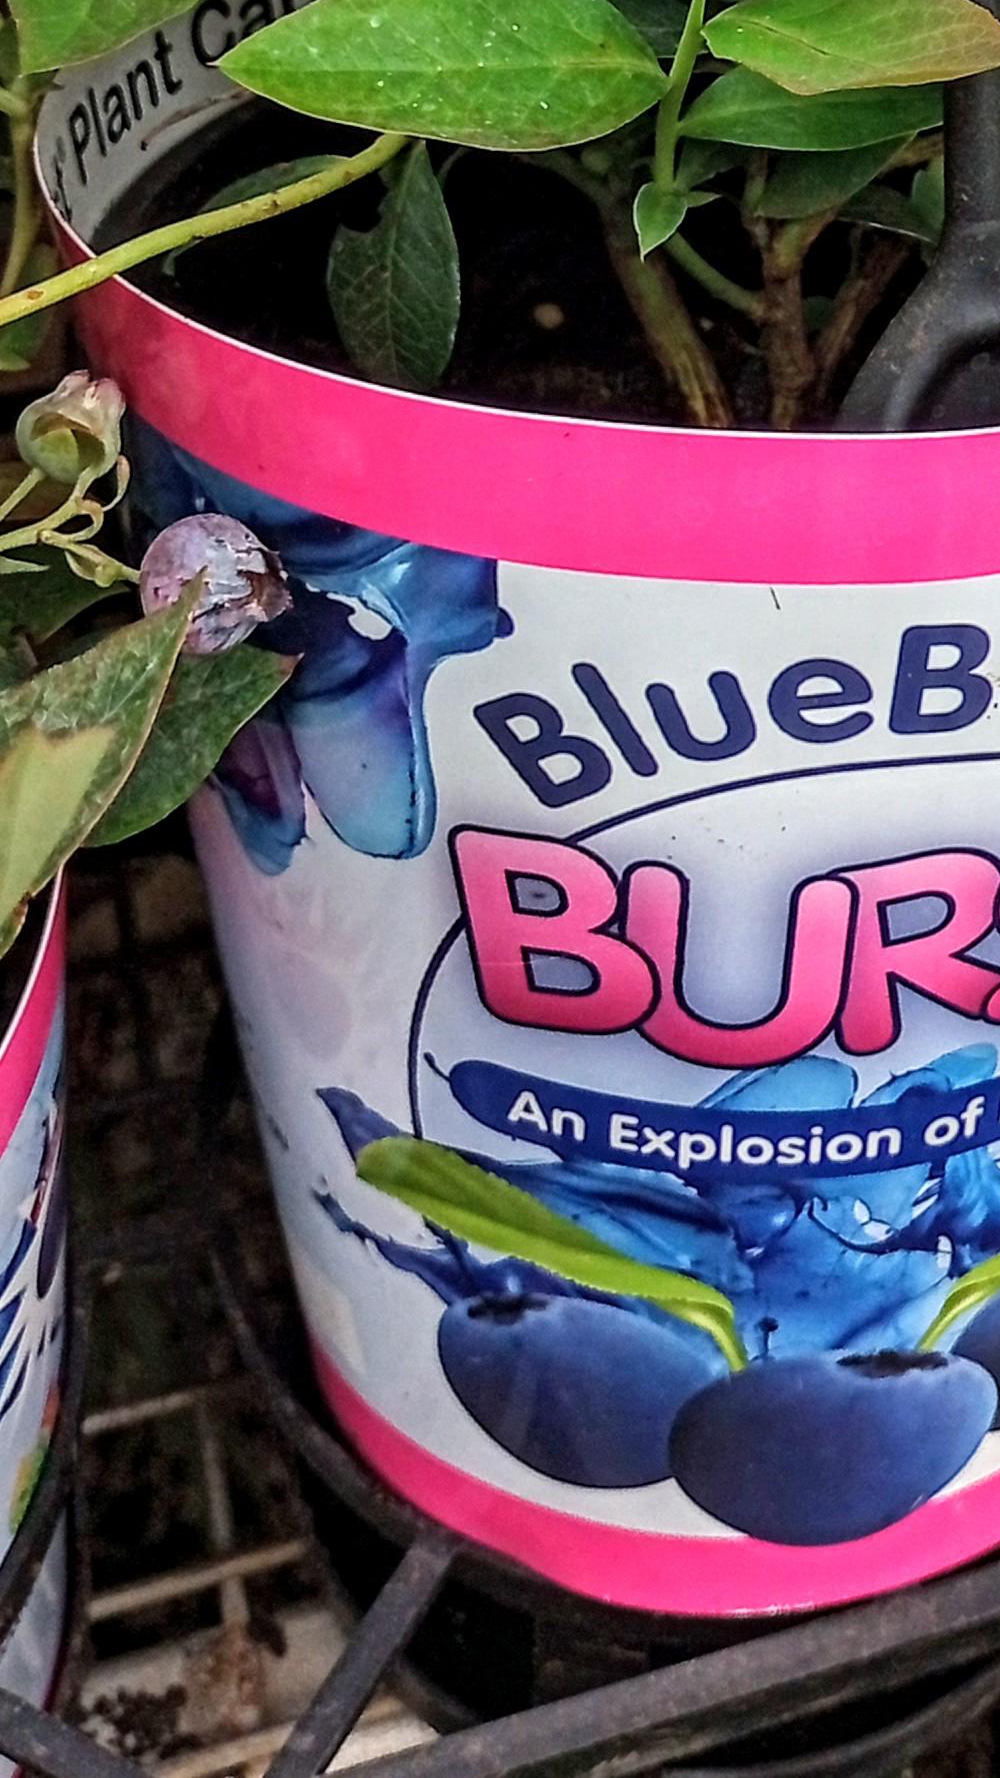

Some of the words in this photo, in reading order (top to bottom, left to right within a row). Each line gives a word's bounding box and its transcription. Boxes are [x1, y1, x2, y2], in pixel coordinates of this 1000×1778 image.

[67, 28, 184, 185] Plant
[507, 1089, 586, 1143] An
[610, 1114, 901, 1170] Explosion
[924, 1094, 987, 1148] of
